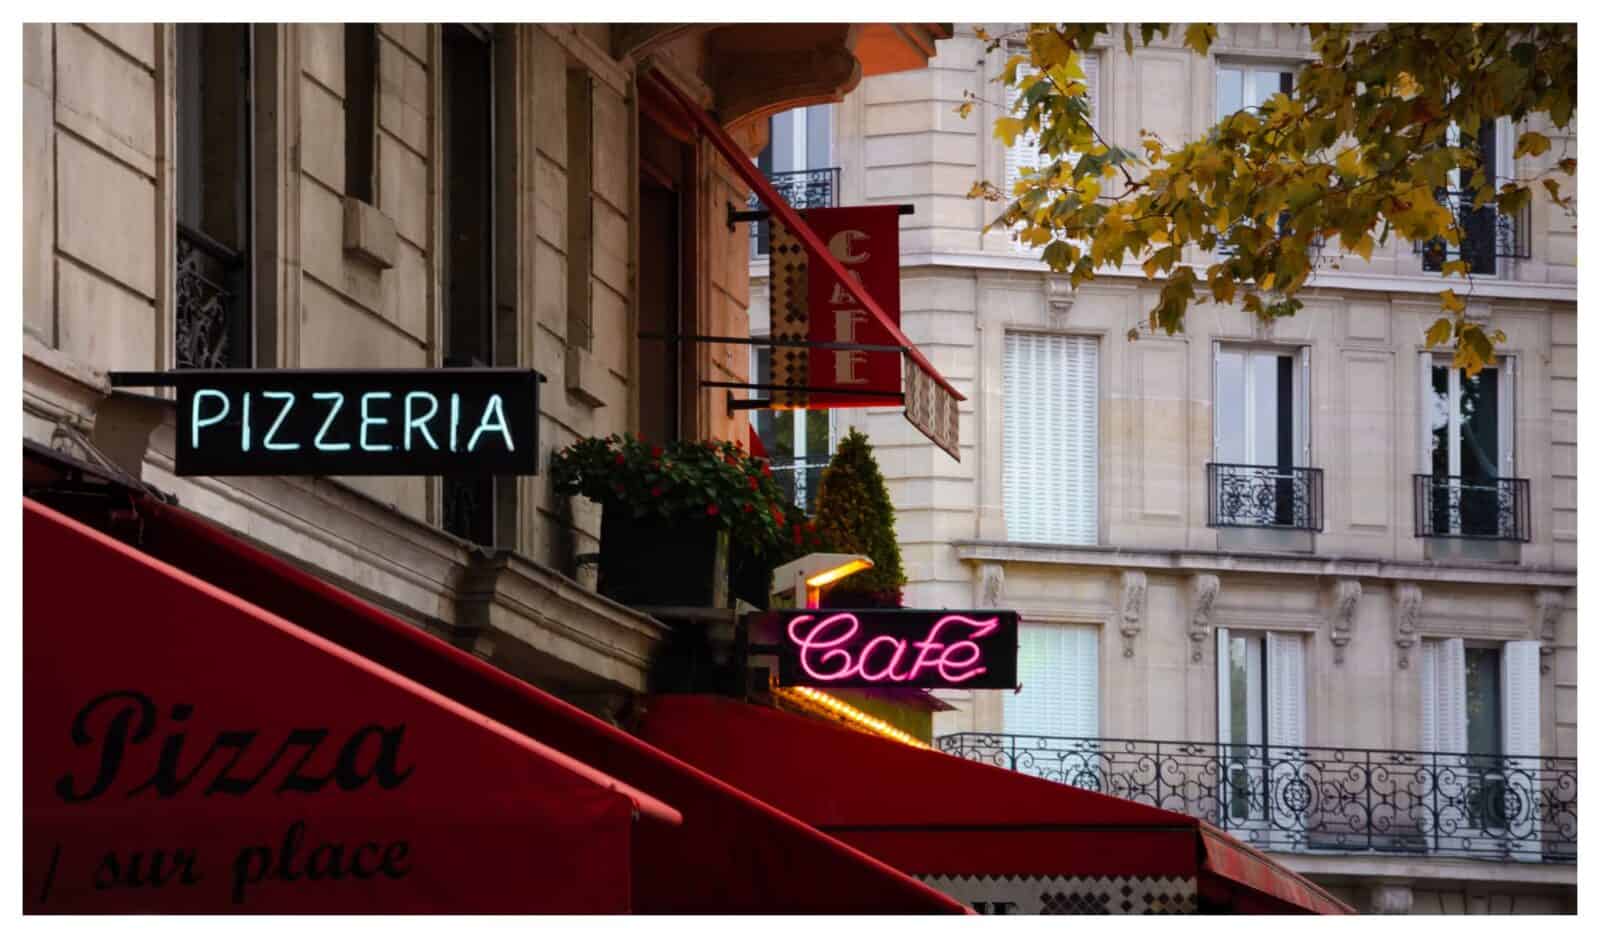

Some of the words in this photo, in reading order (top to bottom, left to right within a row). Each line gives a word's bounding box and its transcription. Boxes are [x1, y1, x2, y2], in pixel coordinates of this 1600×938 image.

[191, 388, 516, 452] PIZZERIA
[787, 612, 999, 681] Café
[55, 688, 416, 804] Pizza
[94, 844, 203, 892] sur
[231, 818, 415, 905] place
